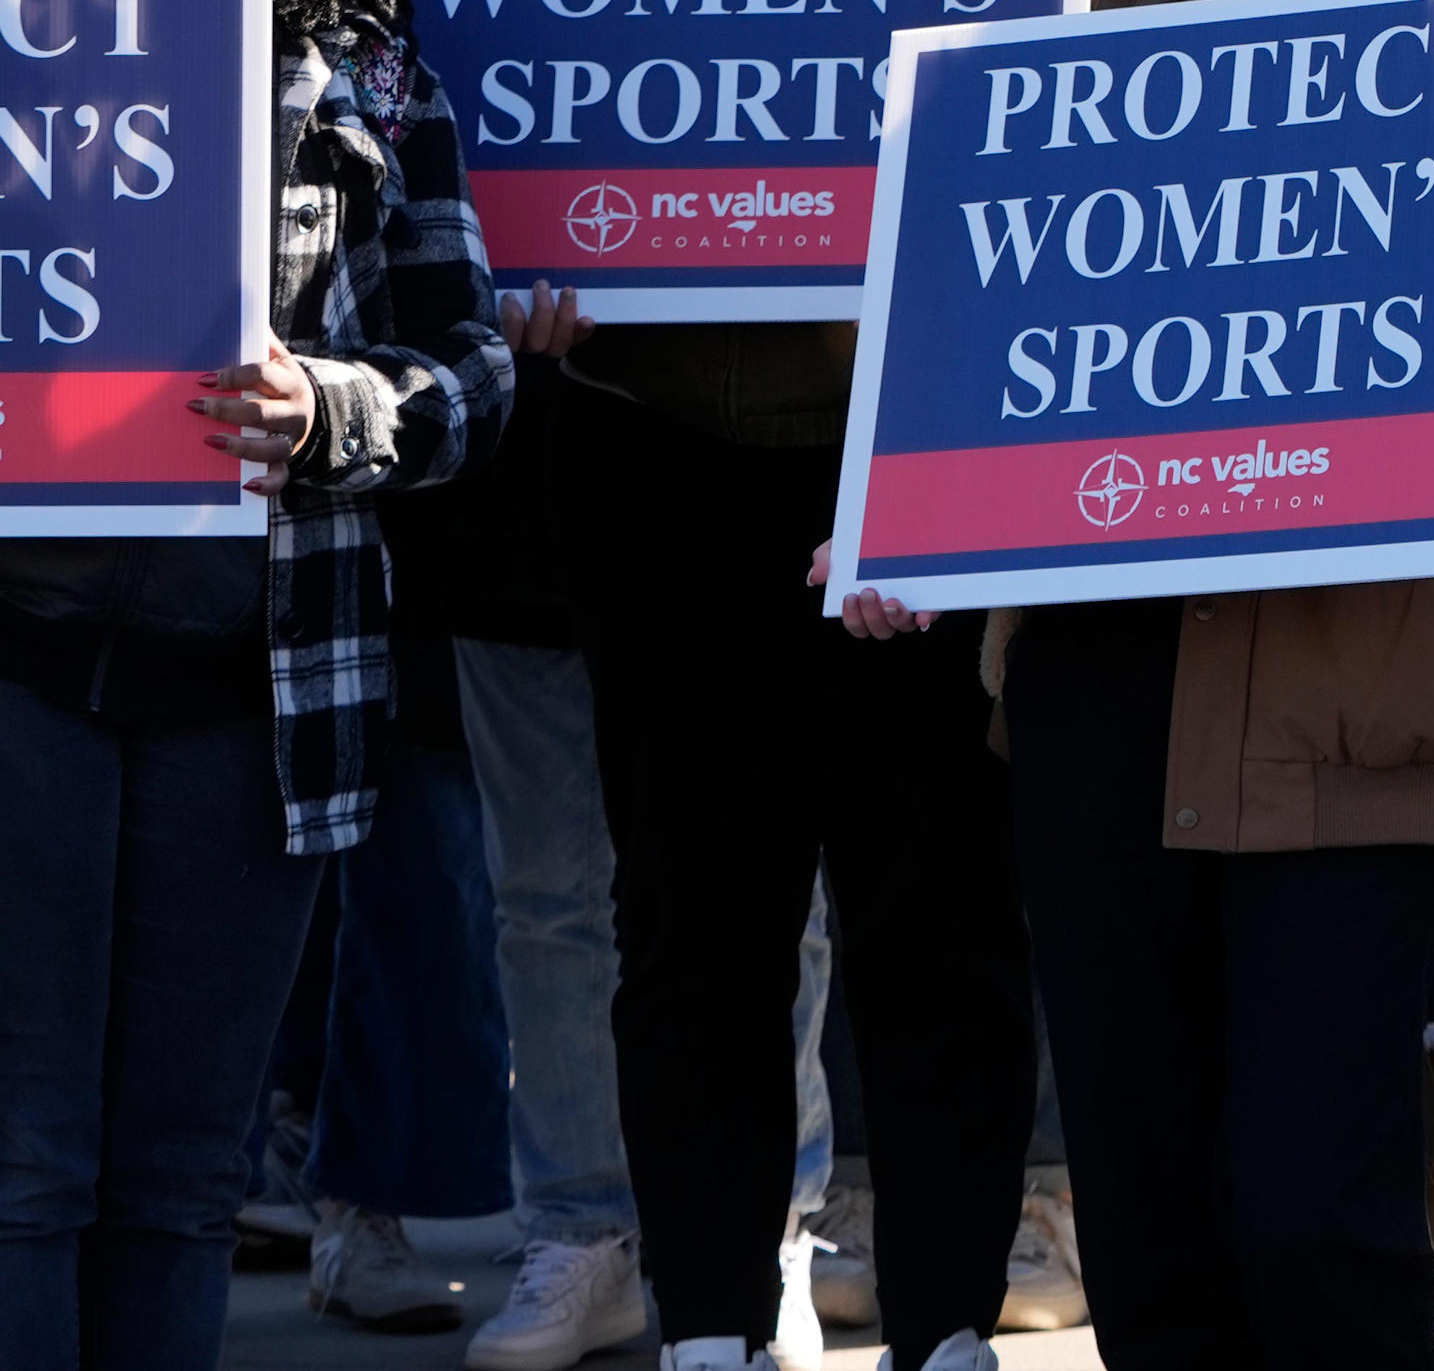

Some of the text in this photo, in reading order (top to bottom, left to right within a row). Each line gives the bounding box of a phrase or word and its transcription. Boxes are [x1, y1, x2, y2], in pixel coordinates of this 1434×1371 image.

[651, 180, 834, 219] nc values
[651, 236, 831, 248] COALITION
[1000, 294, 1424, 420] SPORTS
[1157, 439, 1330, 488] nc values
[1155, 493, 1326, 519] COALITION
